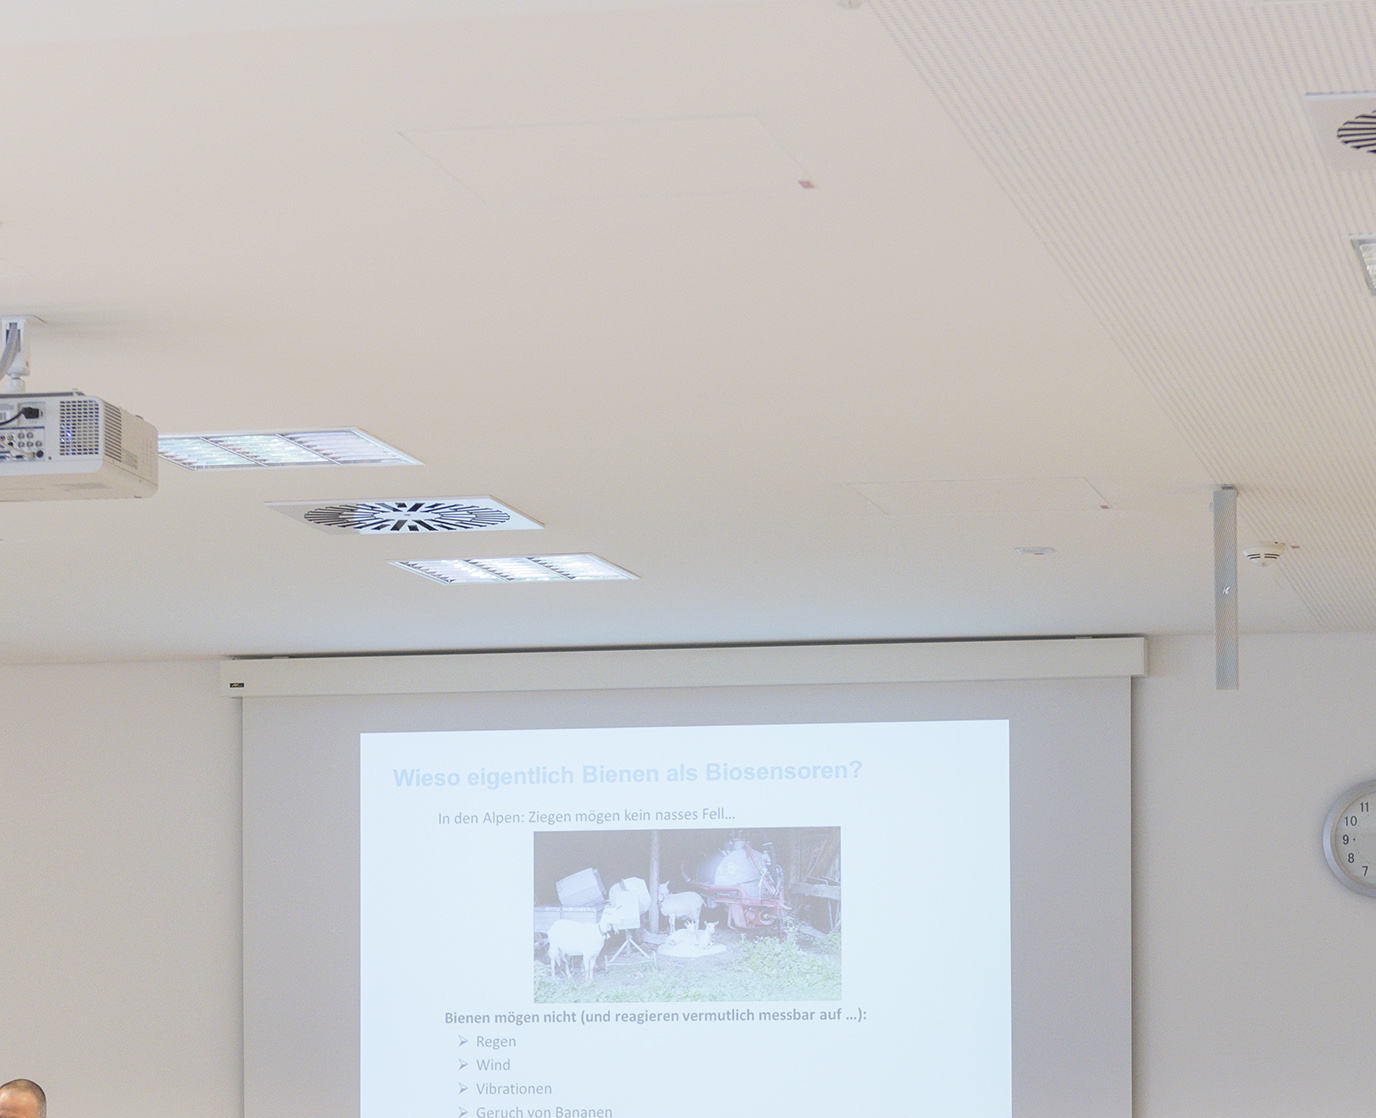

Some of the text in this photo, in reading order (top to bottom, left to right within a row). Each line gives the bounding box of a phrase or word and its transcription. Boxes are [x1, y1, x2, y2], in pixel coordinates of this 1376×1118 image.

[392, 759, 863, 791] Wieso eigentlich Bienen als Biosensoren?
[1360, 802, 1369, 812] 11
[438, 812, 451, 825] In
[453, 811, 479, 825] den
[482, 810, 525, 827] Alpen:
[528, 810, 572, 826] Ziegen
[575, 811, 621, 825] mögen
[624, 808, 651, 822] kein
[656, 811, 698, 820] nasses
[1344, 816, 1357, 826] 10
[1342, 834, 1349, 845] 9
[1348, 853, 1354, 863] 8
[1362, 866, 1368, 876] 7
[444, 1011, 491, 1024] Bienen
[494, 1010, 540, 1027] mögen
[543, 1010, 577, 1023] nicht
[580, 1009, 611, 1026] (und
[615, 1009, 680, 1025] reagieren
[682, 1008, 755, 1022] vermutlich
[758, 1007, 816, 1022] messbar
[819, 1007, 843, 1021] auf
[476, 1035, 517, 1051] Regen
[475, 1058, 511, 1071] Wind
[475, 1082, 553, 1095] Vibrationen
[527, 1109, 551, 1118] von
[555, 1106, 613, 1118] Bananen
